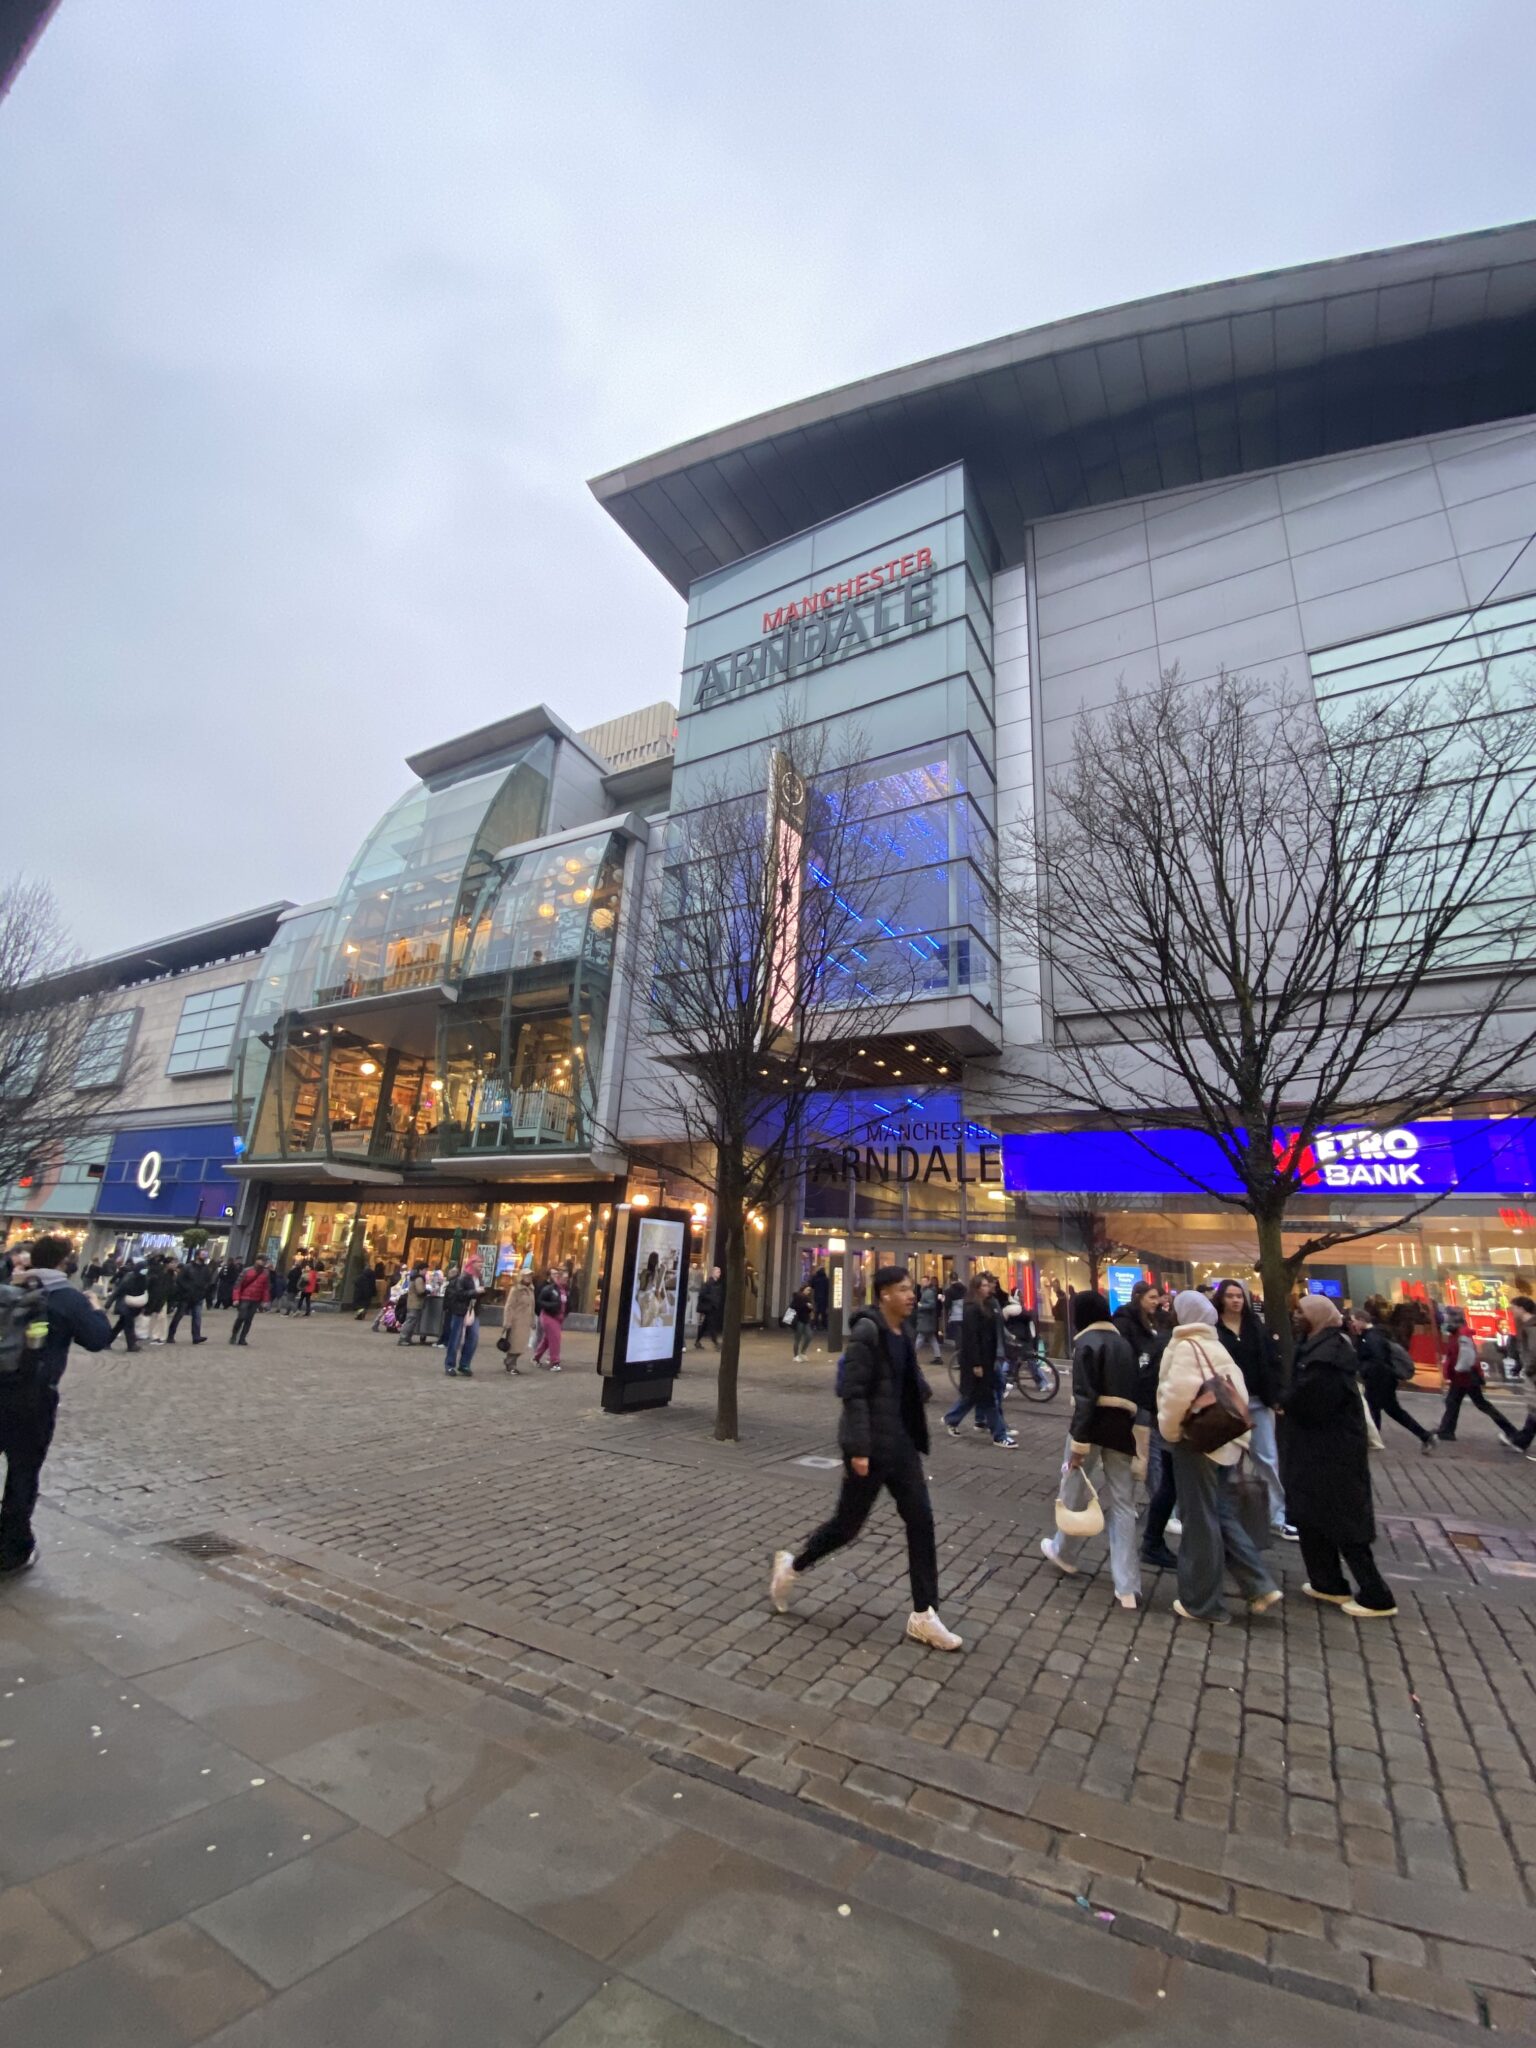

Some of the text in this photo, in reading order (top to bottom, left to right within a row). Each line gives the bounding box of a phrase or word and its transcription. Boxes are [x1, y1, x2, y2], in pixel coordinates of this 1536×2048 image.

[762, 547, 932, 634] MANCHESTER
[693, 575, 932, 705] ARNDALE
[811, 1143, 1001, 1183] ARNDALE
[1324, 1163, 1425, 1186] BANK
